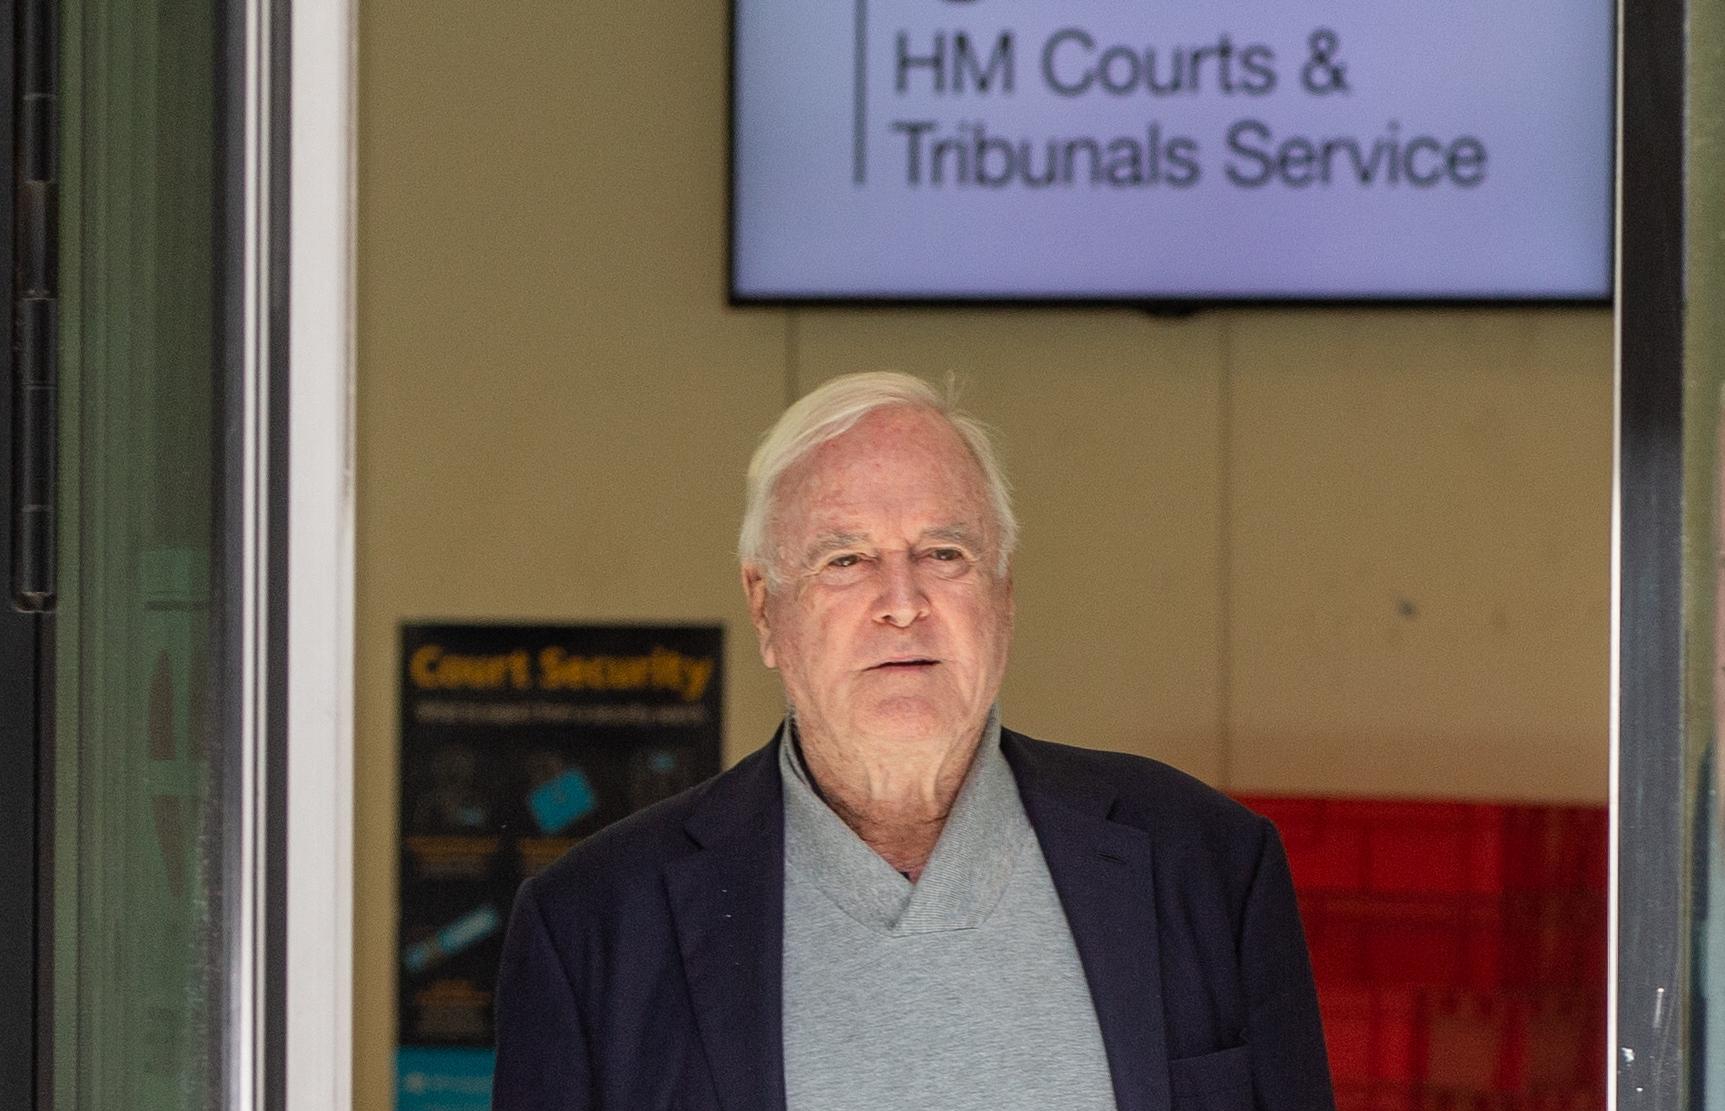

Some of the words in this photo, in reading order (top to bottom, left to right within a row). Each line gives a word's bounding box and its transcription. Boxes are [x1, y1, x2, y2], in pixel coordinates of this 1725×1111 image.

[895, 32, 1014, 95] HM
[1040, 28, 1279, 96] Courts
[1300, 27, 1350, 95] &
[892, 119, 1200, 187] Tribunals
[1224, 120, 1488, 189] Service
[408, 645, 528, 690] Court
[538, 646, 714, 701] Security
